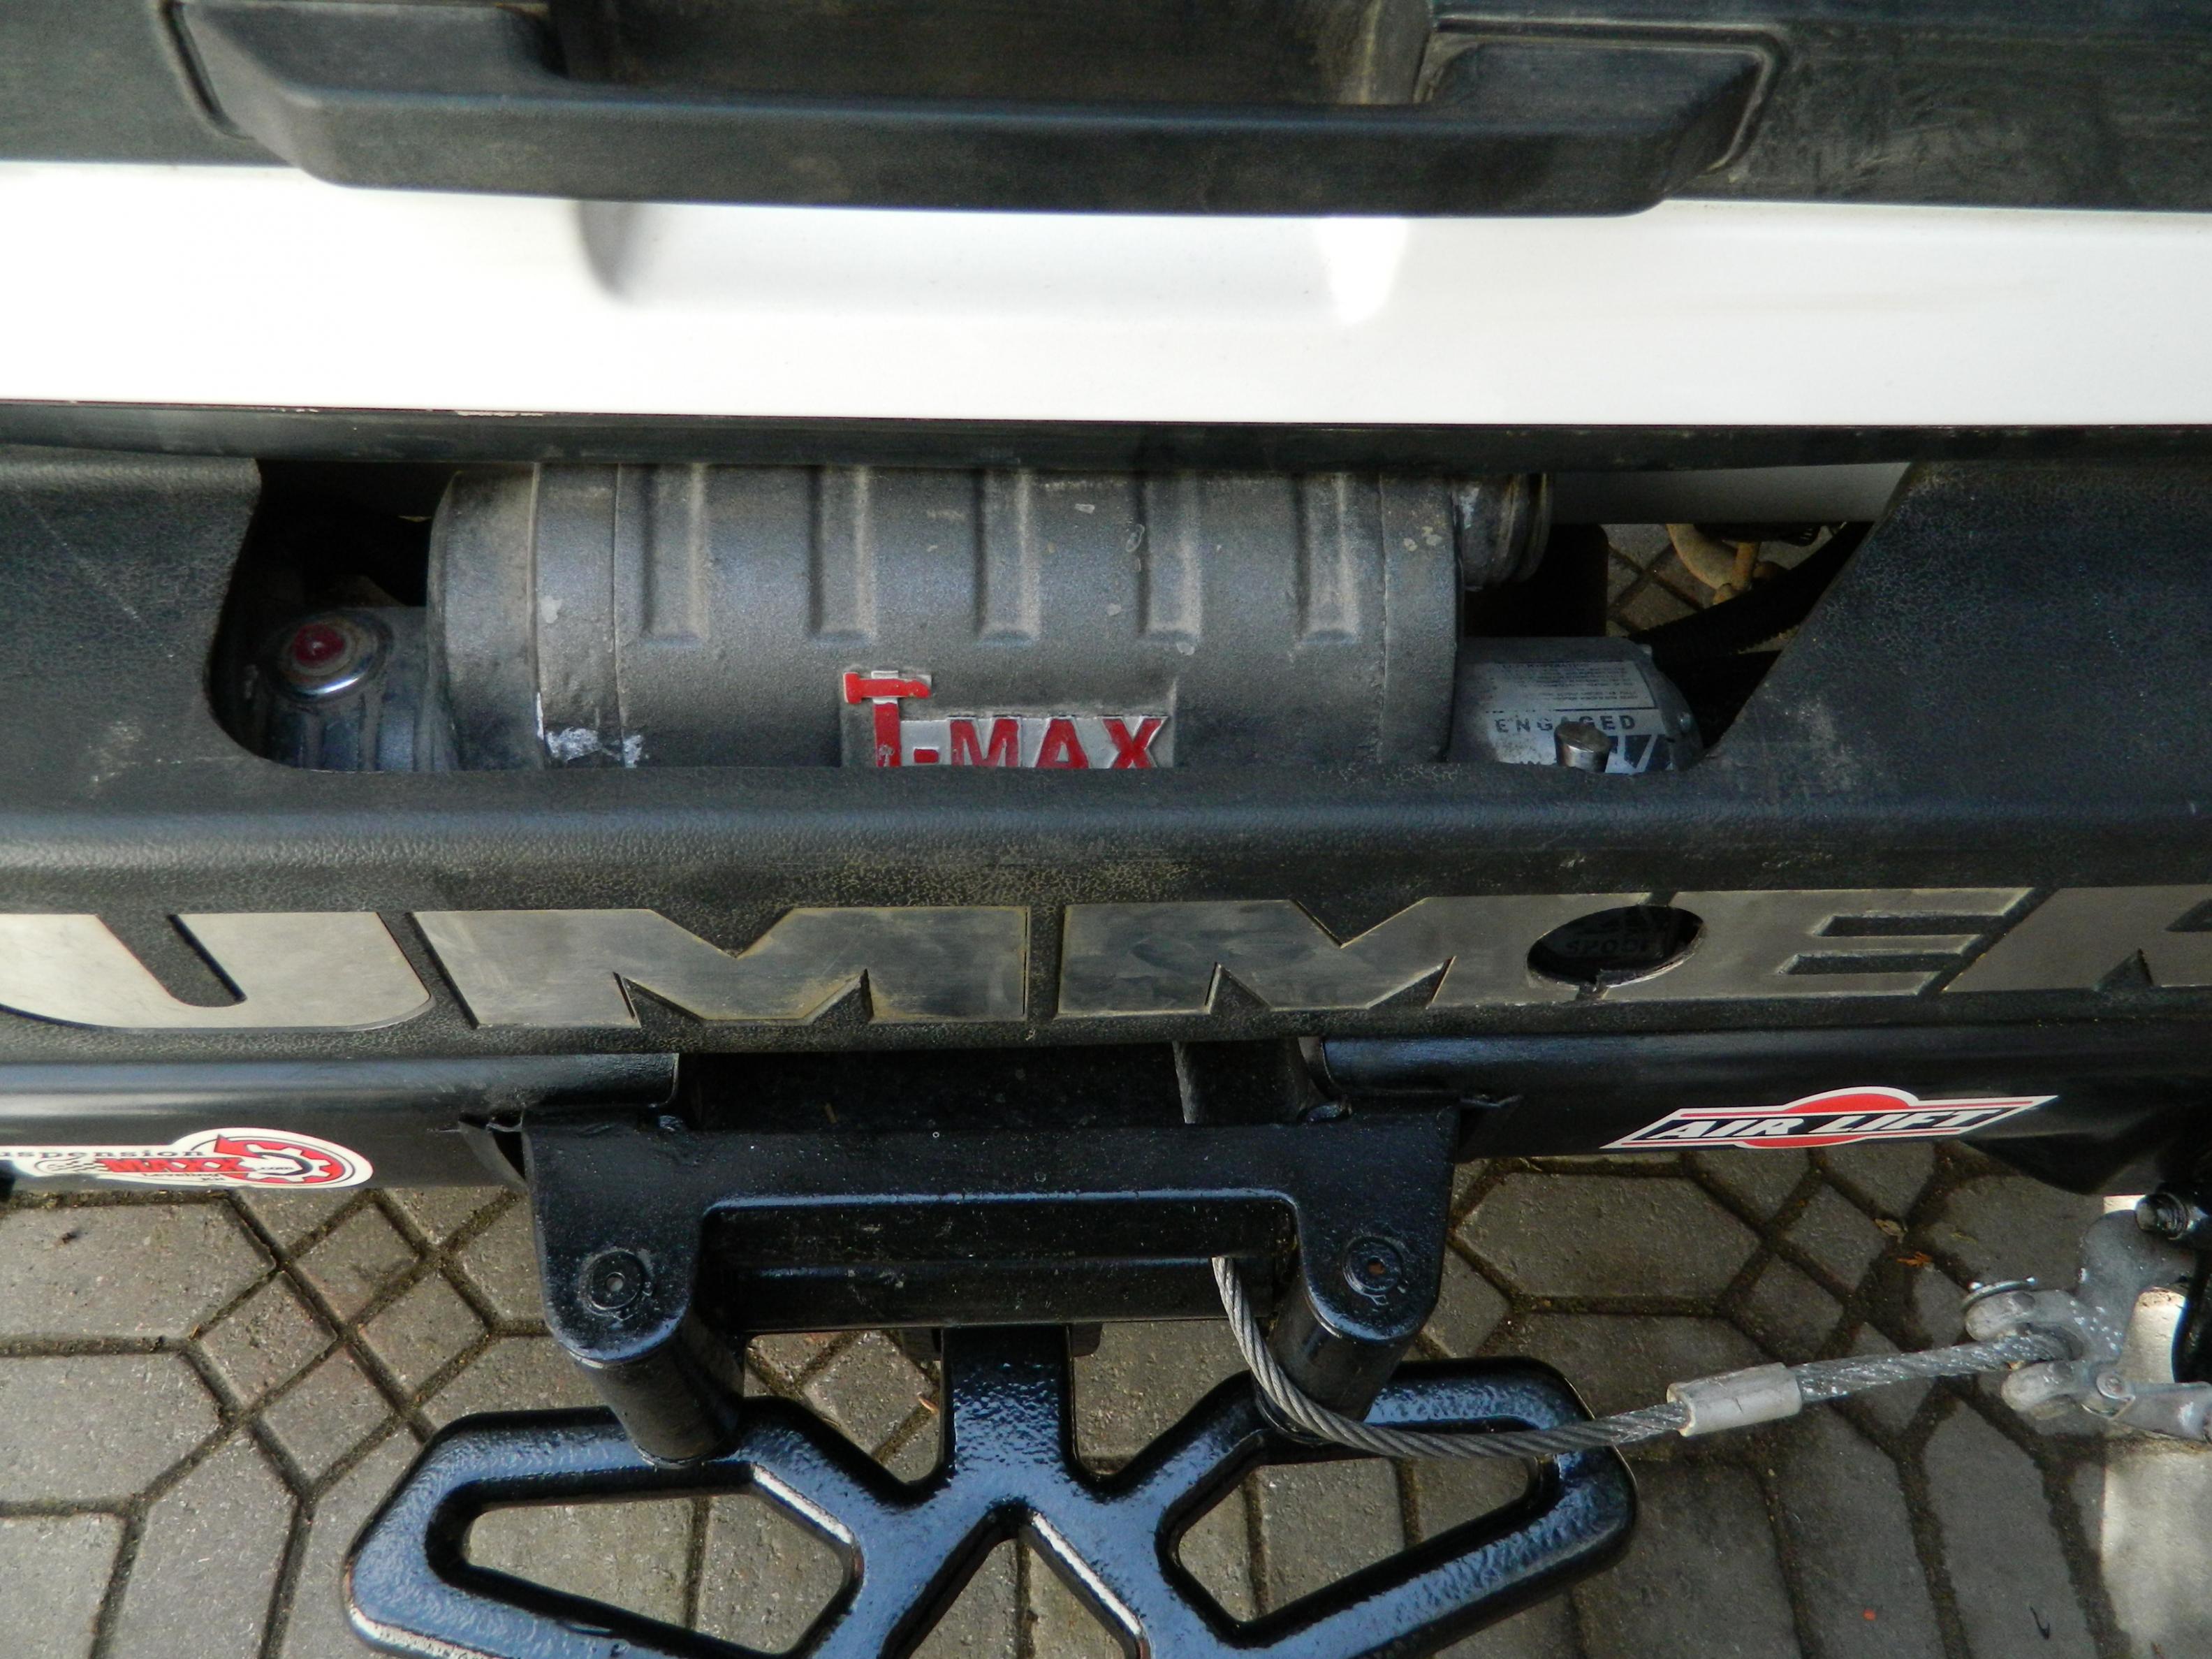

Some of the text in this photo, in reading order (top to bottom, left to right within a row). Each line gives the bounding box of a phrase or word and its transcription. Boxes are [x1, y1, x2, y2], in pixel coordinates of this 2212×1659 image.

[843, 671, 1167, 767] T-MAX
[1495, 715, 1636, 733] ENGGED
[1651, 1108, 2000, 1139] AIR LIFT
